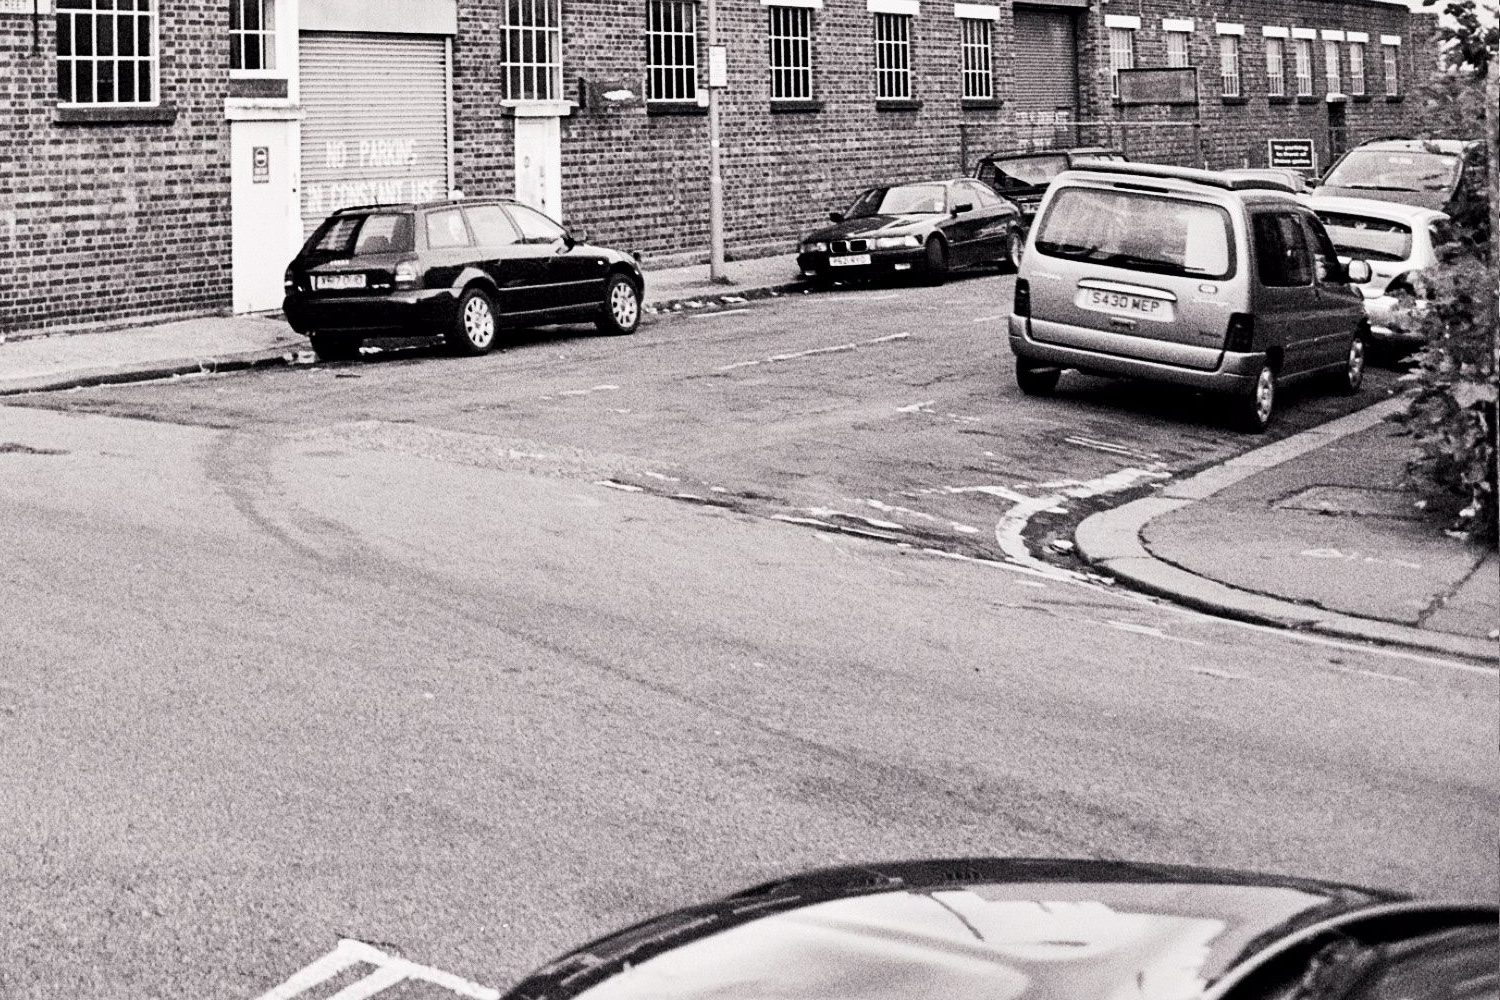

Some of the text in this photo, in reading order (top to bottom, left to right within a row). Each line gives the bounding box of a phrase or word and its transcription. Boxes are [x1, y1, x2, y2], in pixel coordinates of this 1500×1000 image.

[325, 139, 417, 167] NO PARKING
[307, 179, 439, 212] IN CONSTANT USE
[1092, 291, 1128, 309] S430
